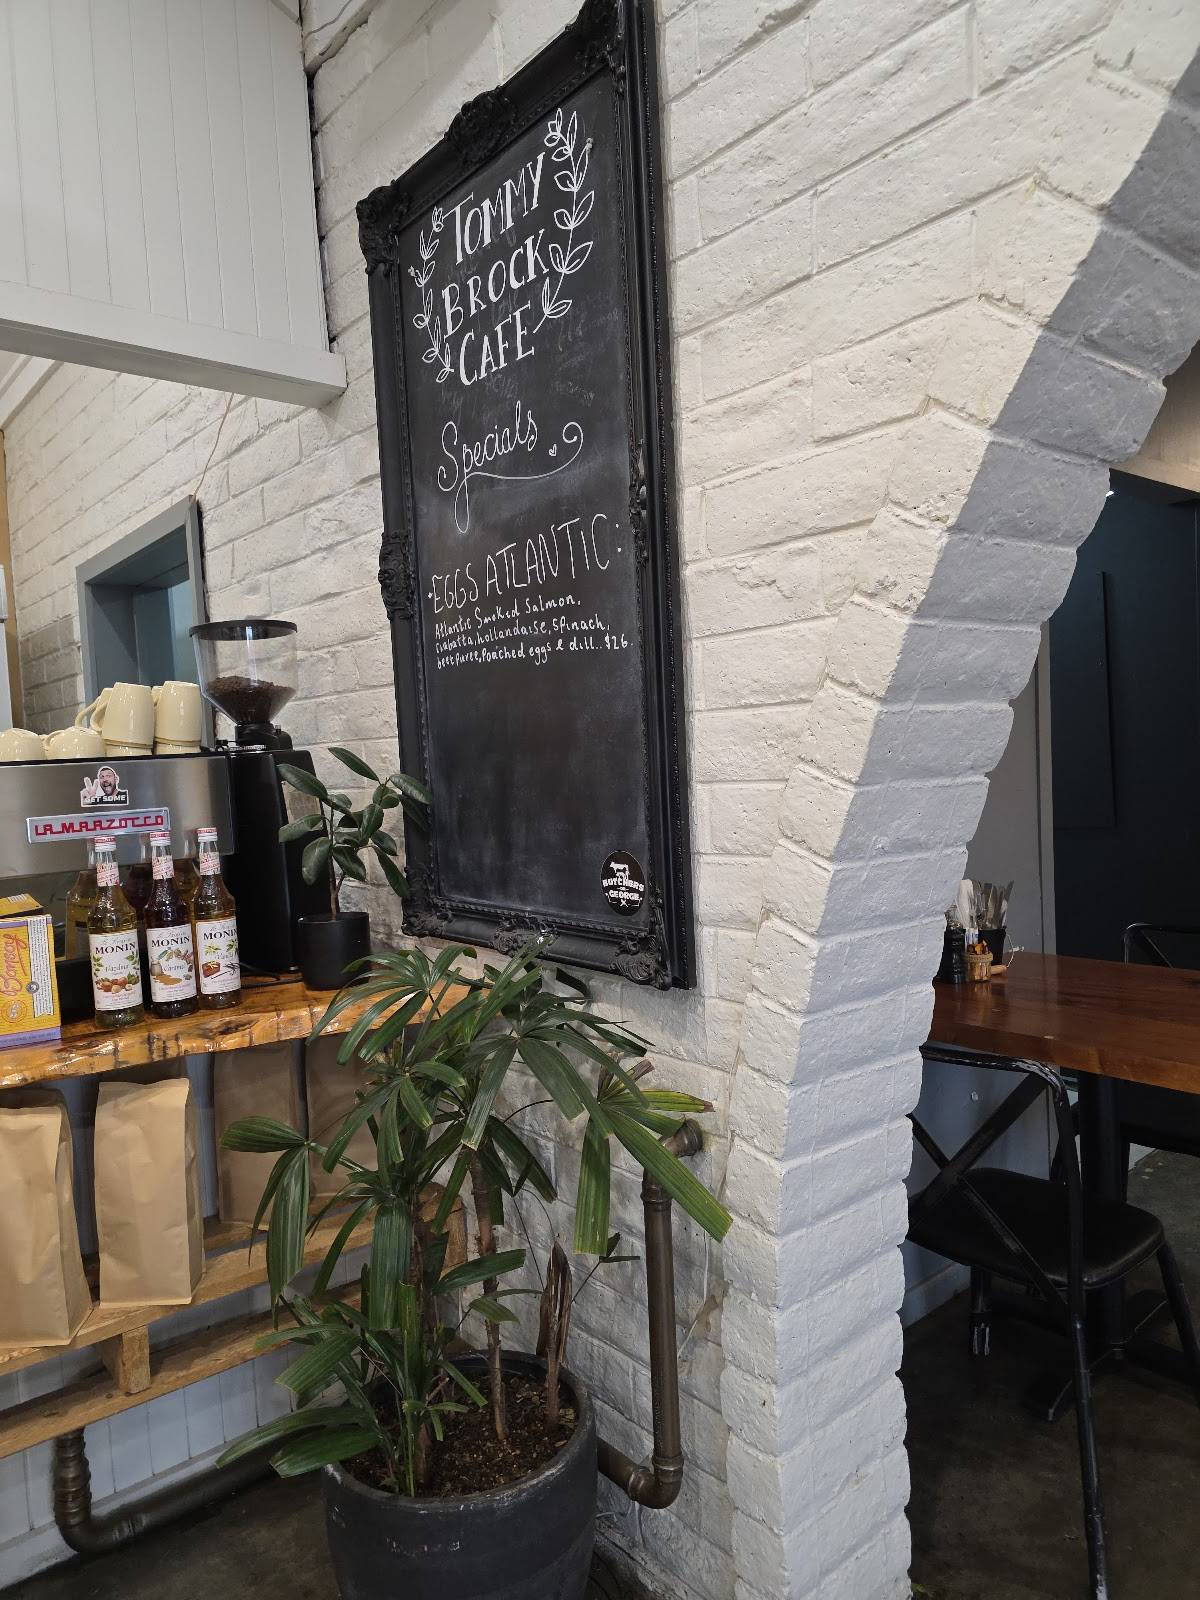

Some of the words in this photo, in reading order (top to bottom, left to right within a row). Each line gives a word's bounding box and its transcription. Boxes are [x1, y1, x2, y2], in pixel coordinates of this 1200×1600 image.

[442, 152, 545, 265] TOMMY
[442, 229, 549, 339] BROCK
[459, 300, 535, 386] CAFE
[438, 400, 538, 533] Specials
[432, 562, 479, 614] EGGS
[435, 615, 472, 640] Atlantic
[475, 597, 520, 629] Smoked
[529, 641, 552, 666] eggs
[95, 942, 136, 955] MONIN
[151, 936, 190, 948] MONIN
[203, 929, 237, 941] MONIN
